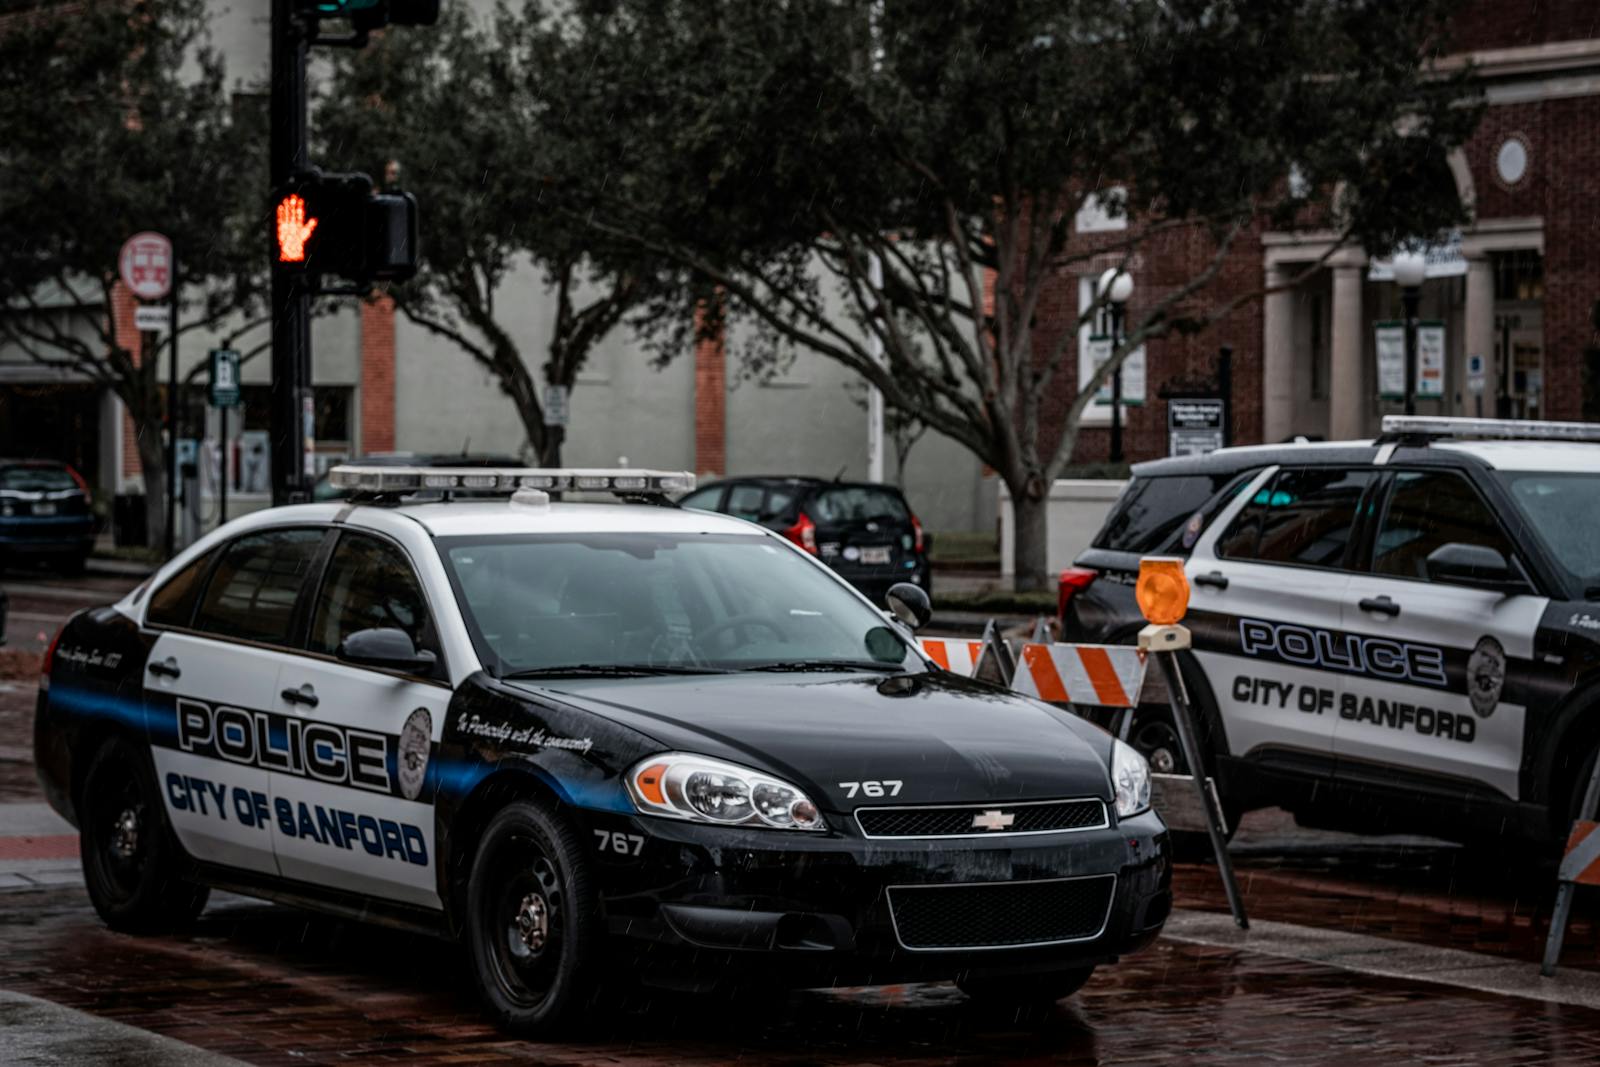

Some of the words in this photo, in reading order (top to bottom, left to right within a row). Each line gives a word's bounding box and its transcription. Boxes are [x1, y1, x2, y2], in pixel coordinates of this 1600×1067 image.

[1239, 619, 1448, 686] POLICE
[1232, 675, 1294, 709] CITY
[1298, 684, 1334, 716] OF
[1339, 693, 1476, 743] SANFORD
[176, 698, 392, 793] POLICE
[166, 772, 230, 820] CITY
[232, 786, 272, 830] OF
[273, 796, 429, 867] SANFORD
[839, 781, 903, 798] 767
[593, 829, 645, 857] 767
